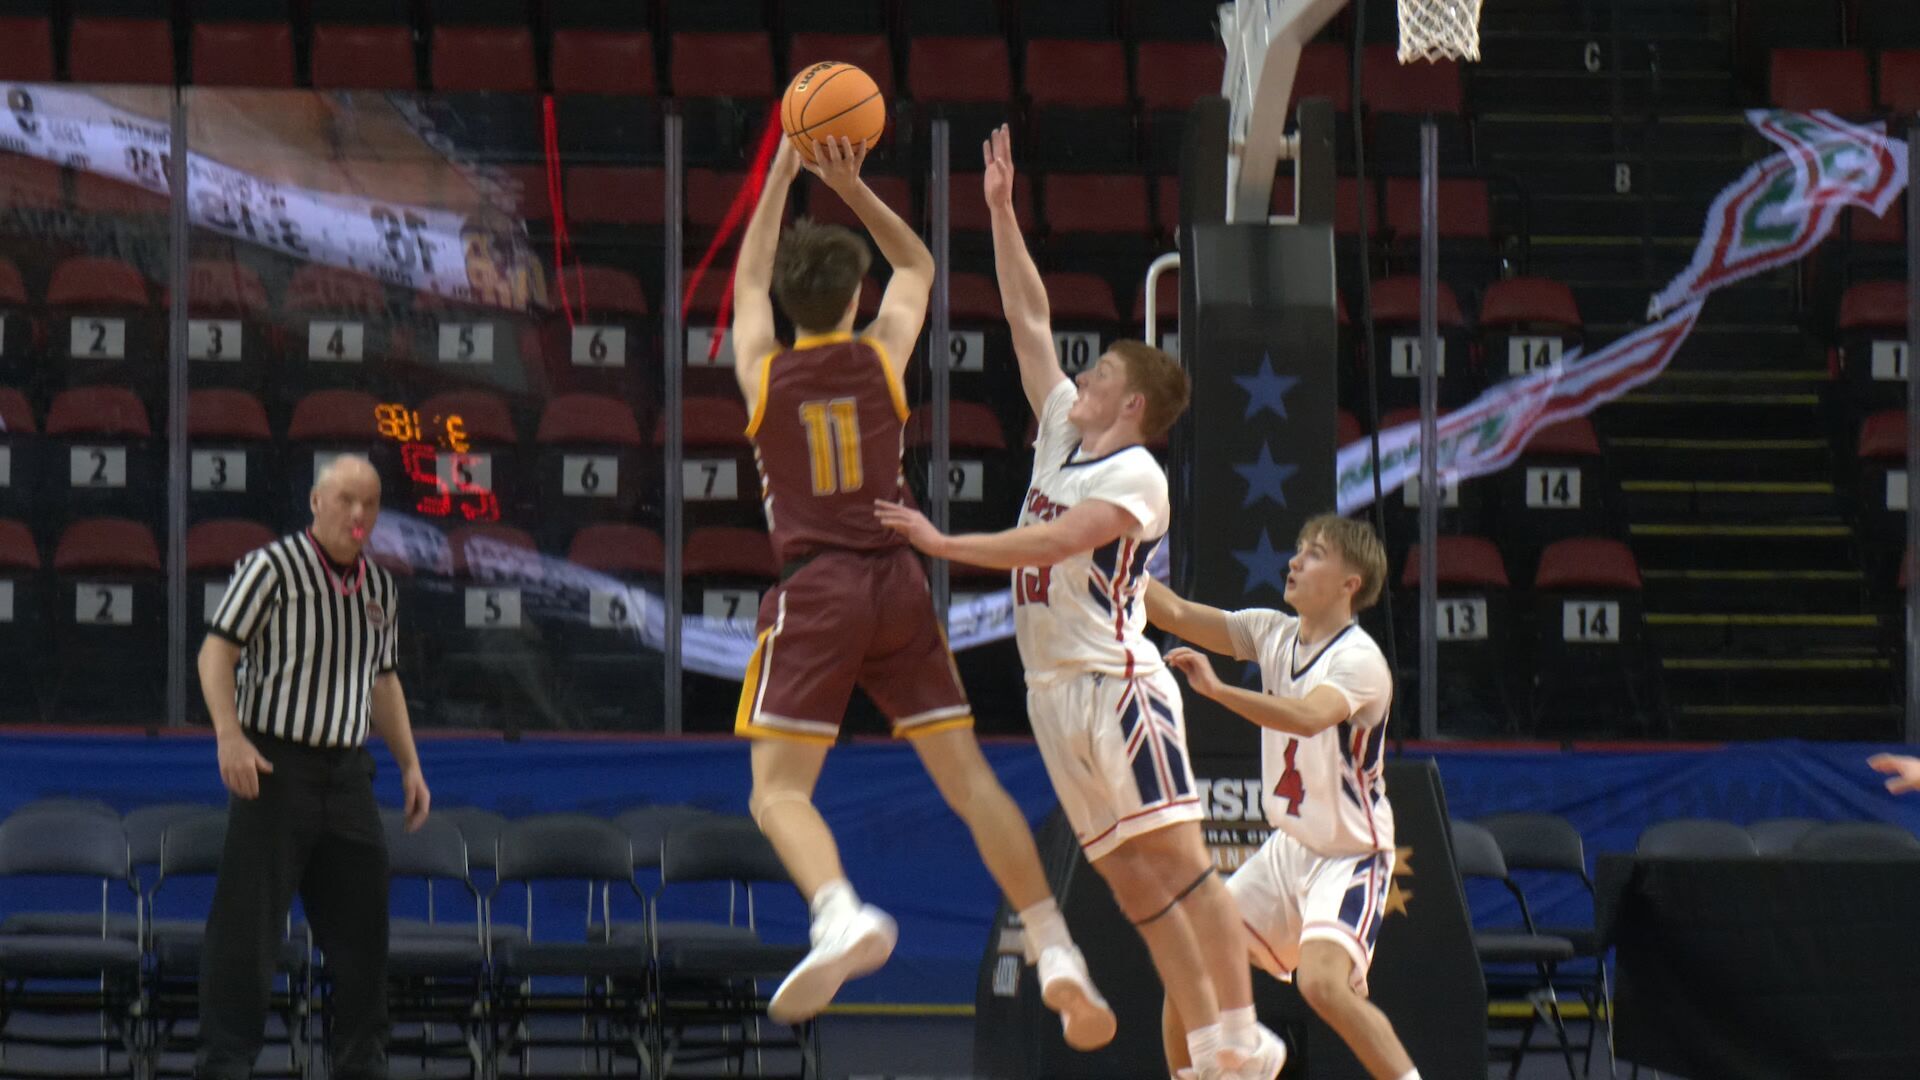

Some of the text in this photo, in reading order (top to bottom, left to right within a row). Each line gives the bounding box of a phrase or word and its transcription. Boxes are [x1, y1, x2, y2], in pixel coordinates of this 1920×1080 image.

[1584, 42, 1600, 73] C
[1615, 162, 1631, 194] B
[89, 319, 107, 354] 2
[207, 326, 223, 357] 3
[326, 326, 346, 358] 4
[457, 326, 475, 358] 5
[589, 327, 608, 363] 6
[950, 335, 967, 368] 9
[1060, 337, 1090, 370] 10
[1521, 340, 1551, 369] 14
[799, 397, 864, 496] 11
[90, 452, 108, 486] 2
[209, 454, 227, 488] 3
[581, 460, 600, 492] 6
[700, 463, 718, 498] 7
[948, 465, 966, 498] 9
[1540, 471, 1571, 505] 14
[95, 590, 114, 622] 2
[484, 592, 502, 624] 5
[607, 594, 627, 623] 6
[721, 595, 740, 624] 7
[1445, 604, 1477, 635] 13
[1577, 605, 1610, 638] 14
[1273, 737, 1306, 819] 4
